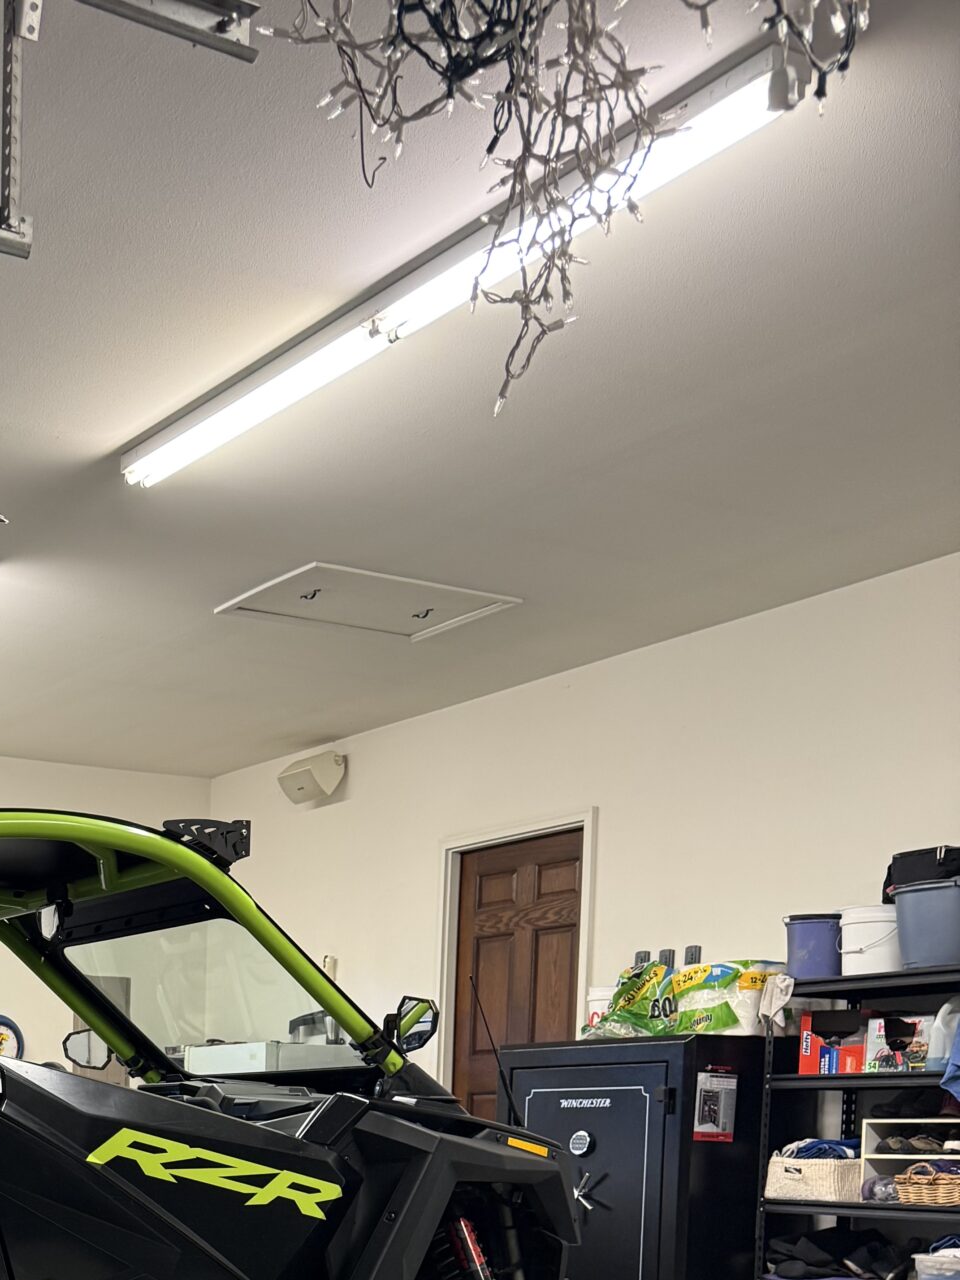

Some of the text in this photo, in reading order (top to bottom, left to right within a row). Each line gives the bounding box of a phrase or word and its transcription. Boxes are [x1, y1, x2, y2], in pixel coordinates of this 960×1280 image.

[803, 1031, 811, 1055] Hefty
[560, 1098, 612, 1108] WINCHESTER
[86, 1127, 343, 1220] RZR
